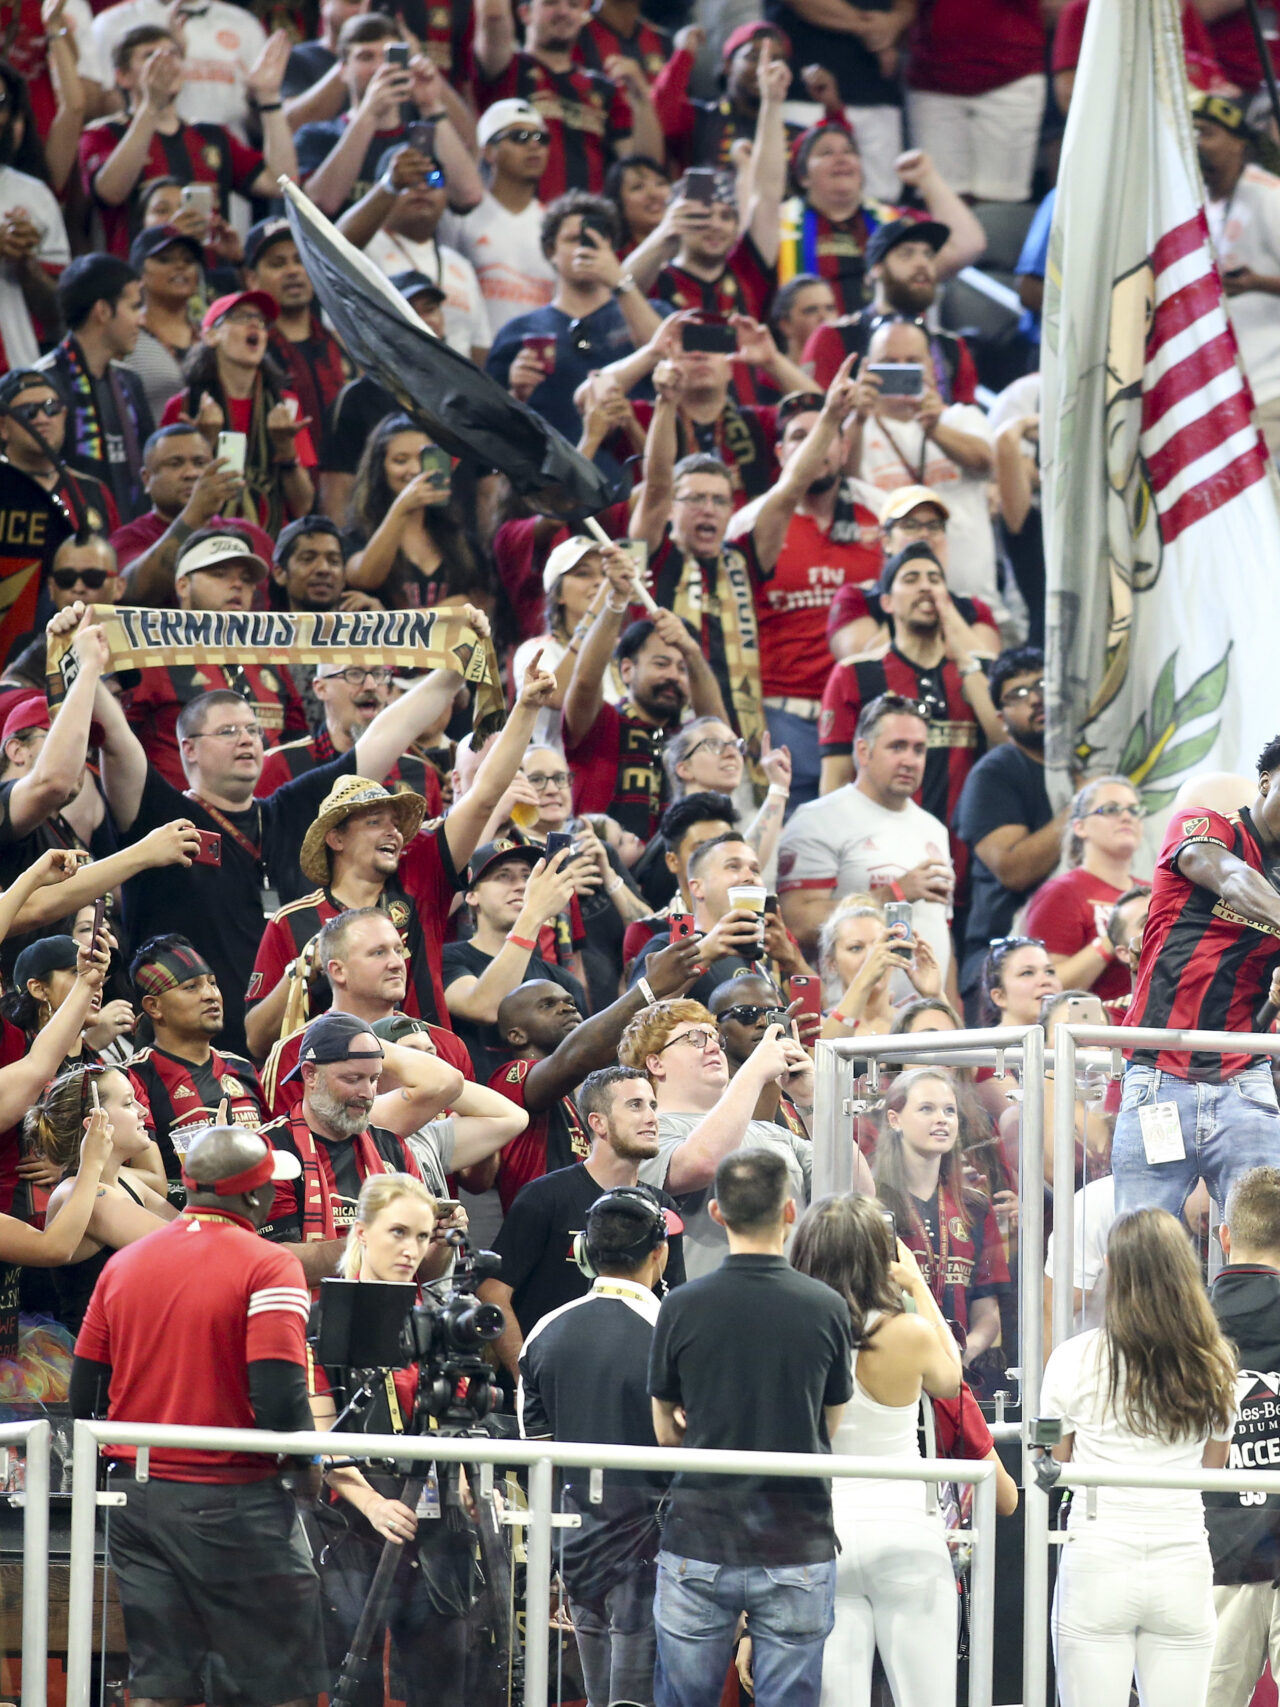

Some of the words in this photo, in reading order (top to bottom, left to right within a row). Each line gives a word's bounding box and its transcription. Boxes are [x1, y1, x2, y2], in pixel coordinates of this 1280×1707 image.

[115, 608, 297, 650] TERMINUS
[309, 610, 439, 650] LEGION
[1238, 1420, 1279, 1435] DIUM
